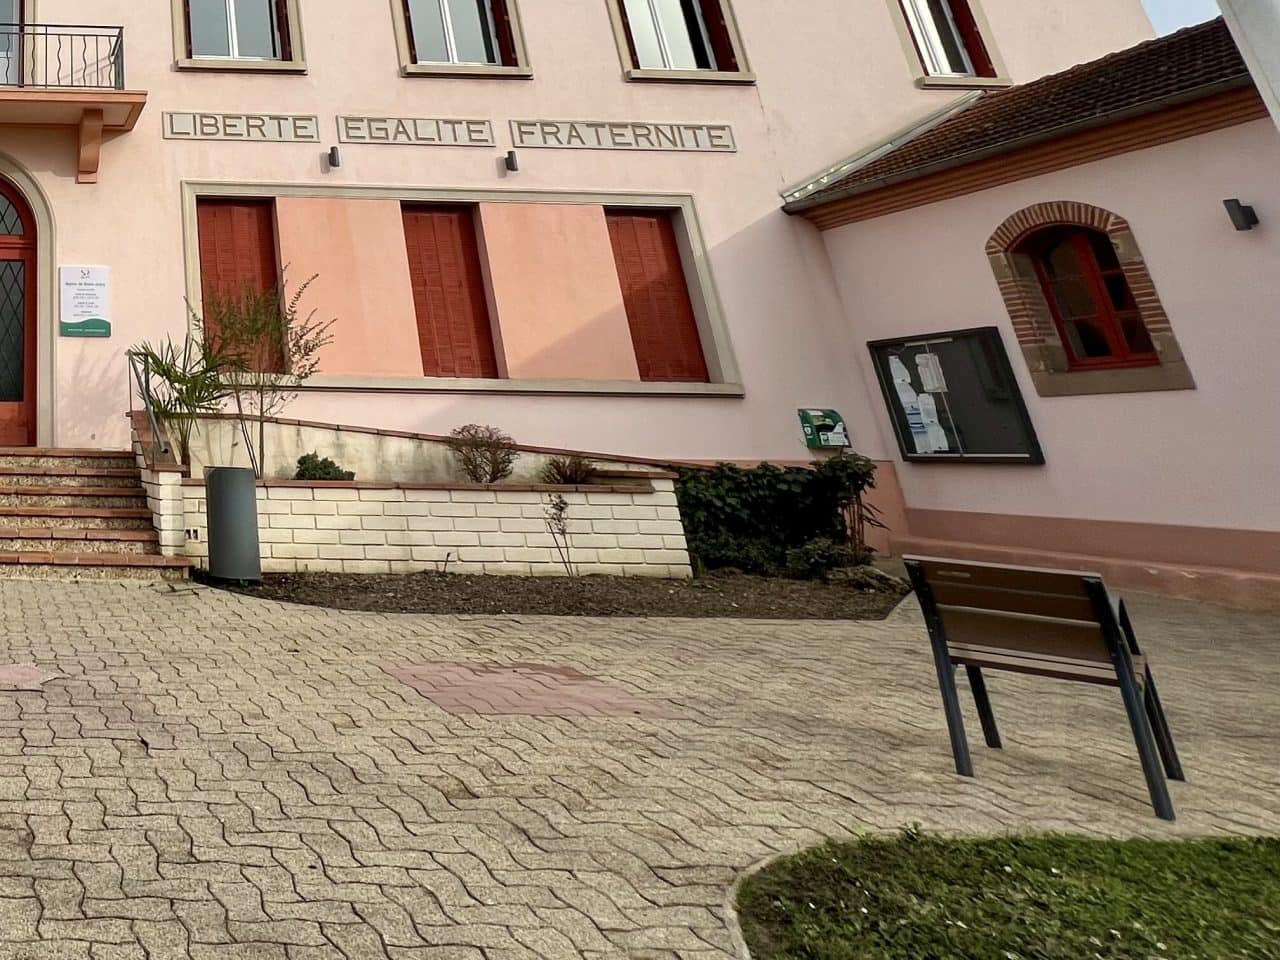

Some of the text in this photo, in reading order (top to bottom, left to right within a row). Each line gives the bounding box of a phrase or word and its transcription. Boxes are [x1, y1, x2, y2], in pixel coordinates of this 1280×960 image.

[170, 113, 315, 139] LIBERTE
[344, 118, 489, 143] EGALITE
[518, 122, 731, 149] FRATERNITE
